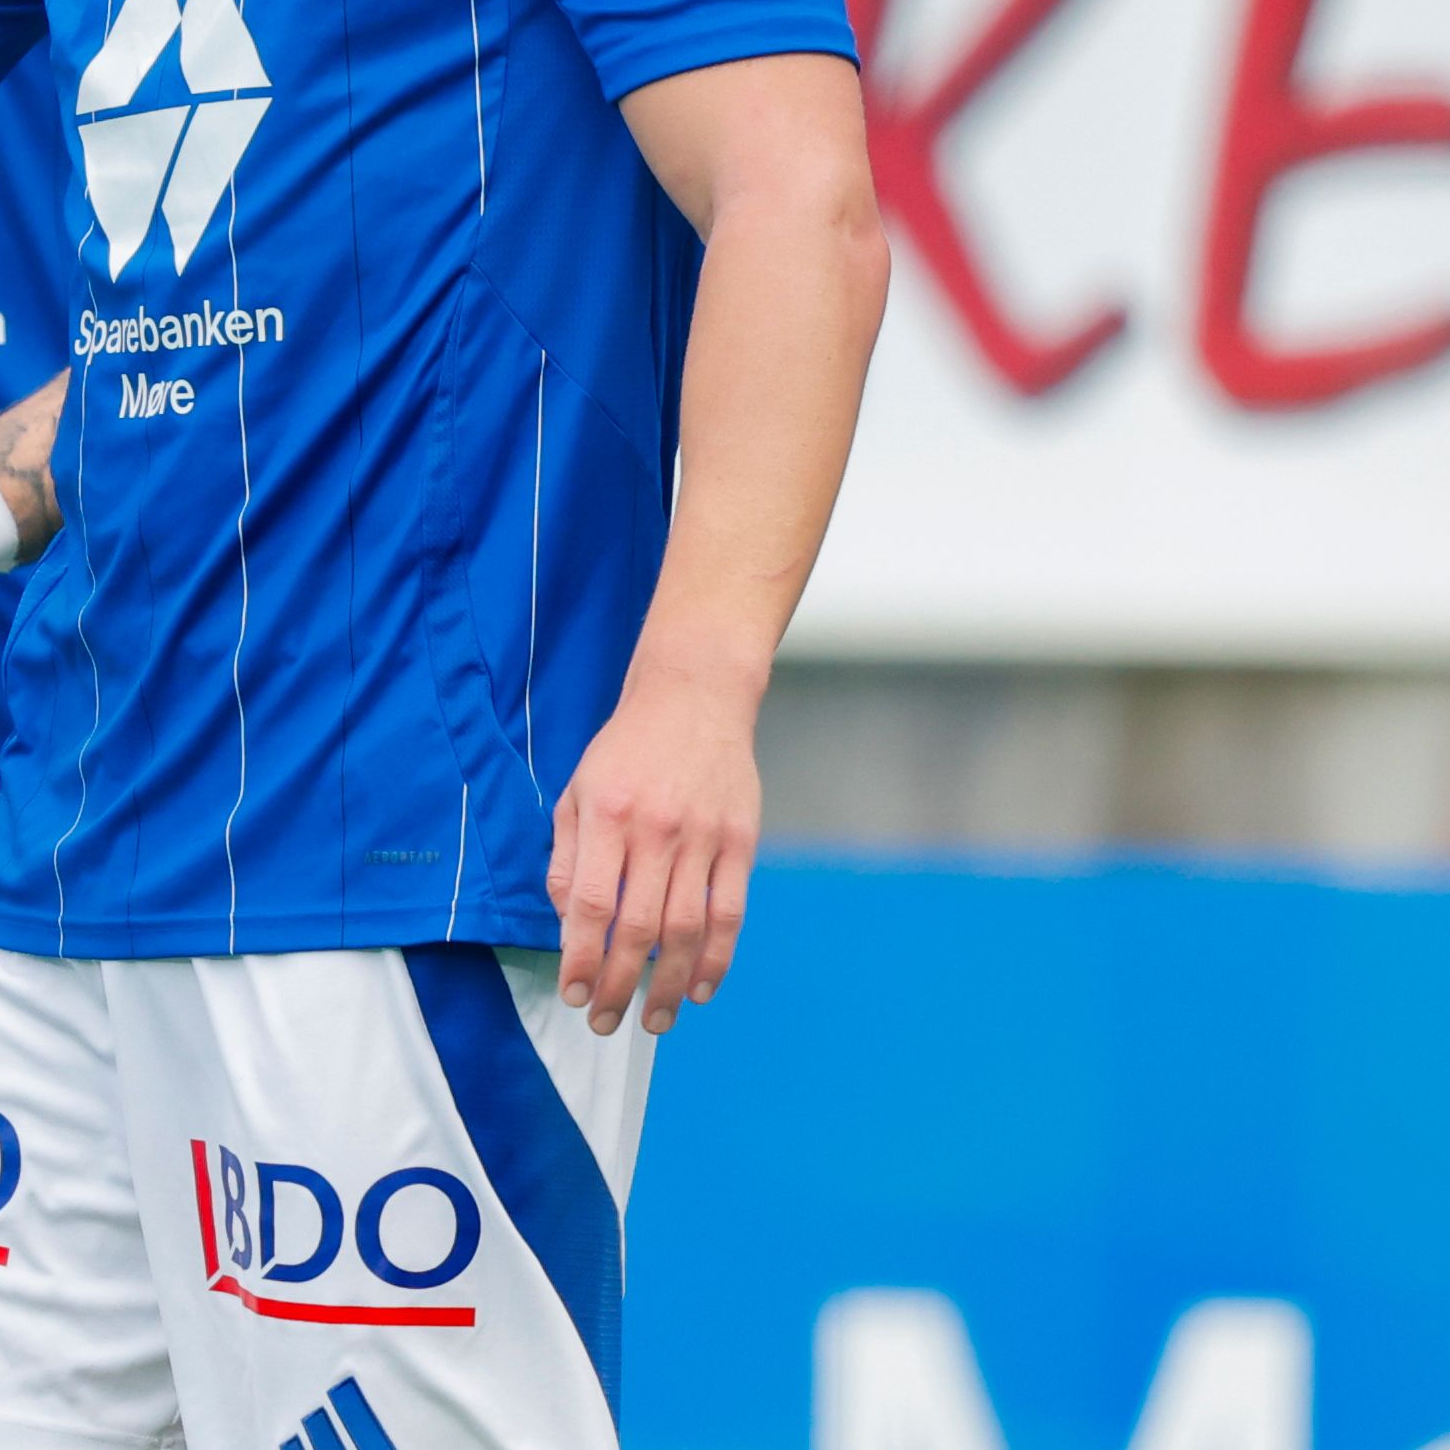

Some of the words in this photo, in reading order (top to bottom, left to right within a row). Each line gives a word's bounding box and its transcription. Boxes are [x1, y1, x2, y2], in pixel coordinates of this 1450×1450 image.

[74, 300, 283, 365] Sparebanken
[119, 373, 195, 418] Møre
[219, 1144, 481, 1289] BDO
